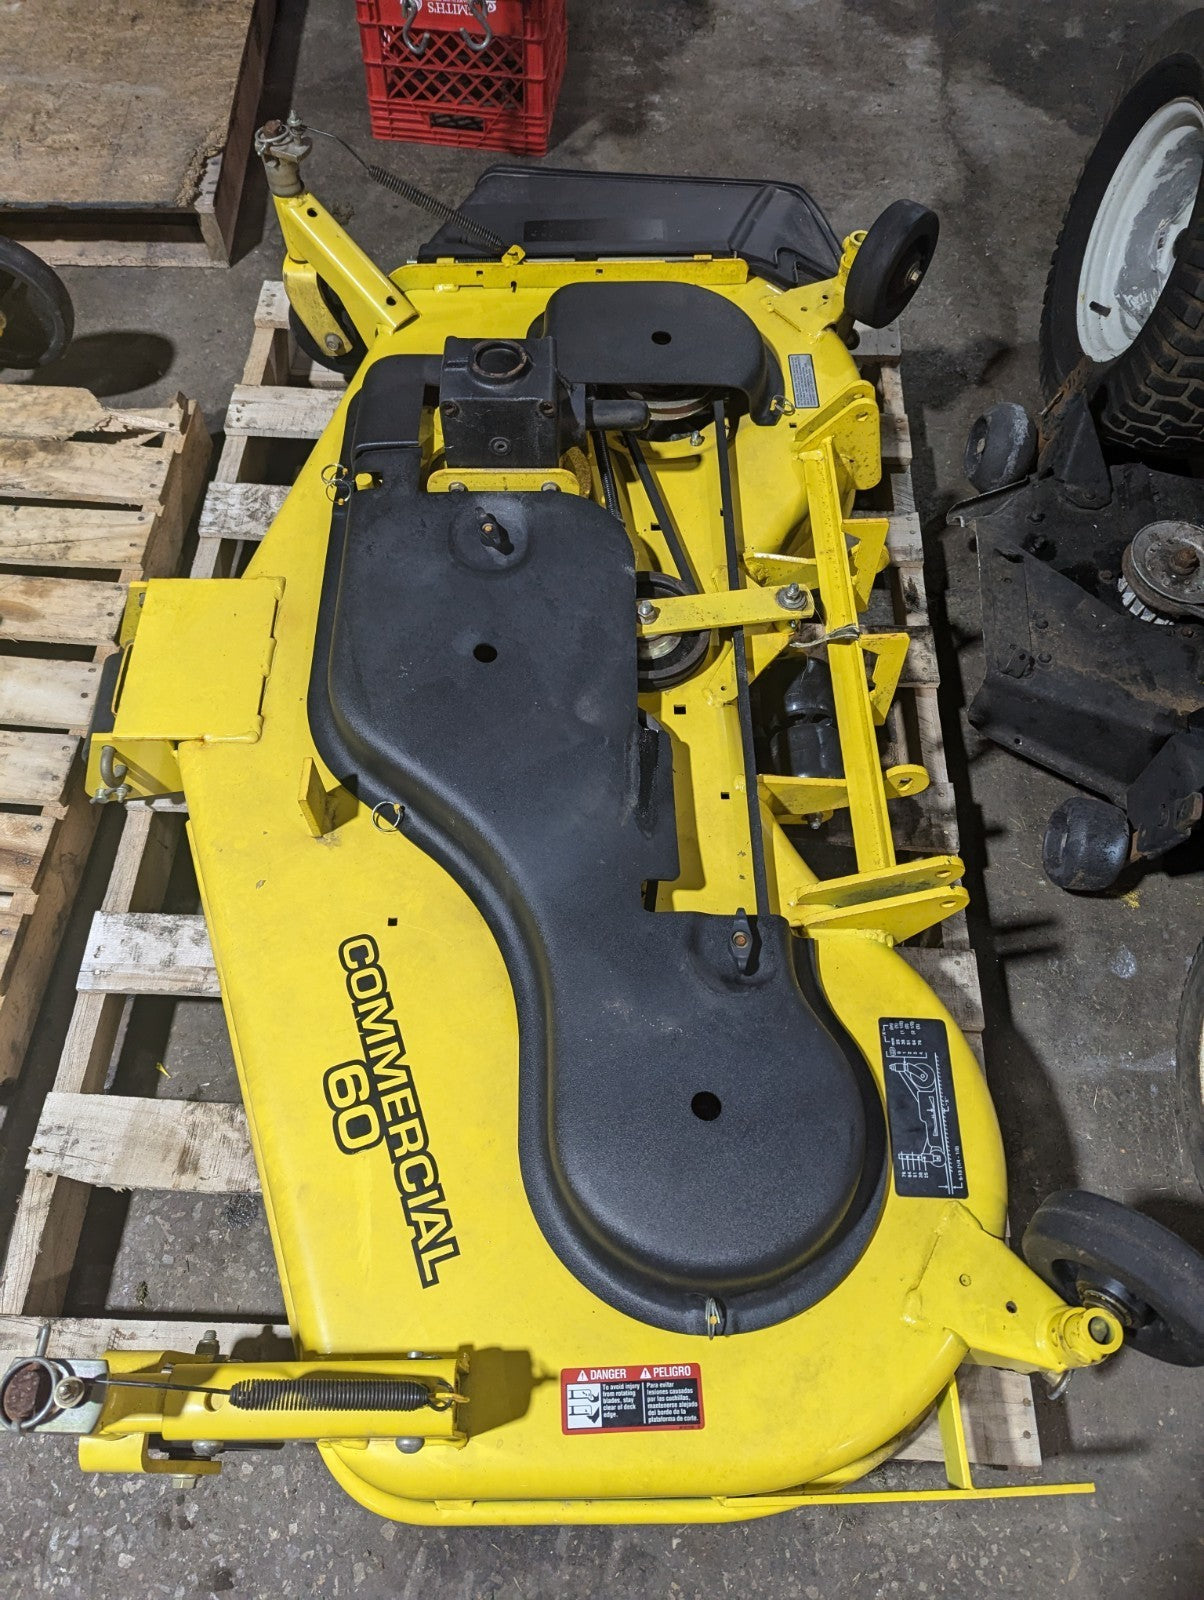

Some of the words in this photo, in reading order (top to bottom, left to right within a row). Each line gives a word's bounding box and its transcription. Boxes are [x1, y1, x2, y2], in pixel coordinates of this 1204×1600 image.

[428, 2, 474, 16] MITH'S
[323, 1059, 384, 1155] 60
[338, 934, 460, 1289] COMMERCIAL
[590, 1368, 627, 1380] DANGER
[654, 1366, 691, 1378] PELIGRO
